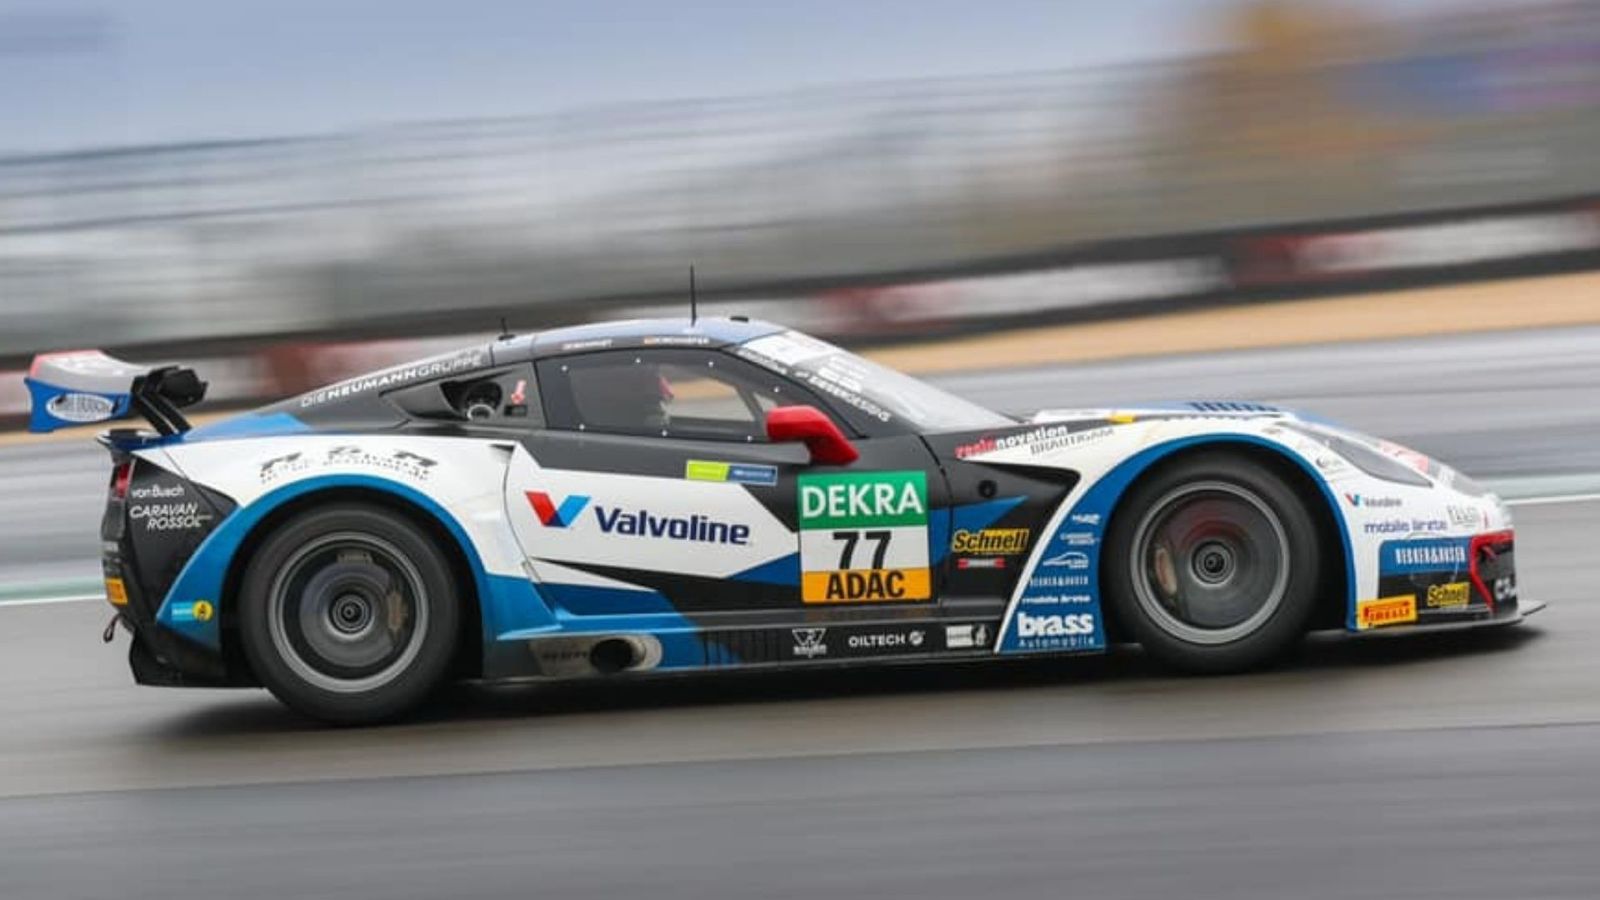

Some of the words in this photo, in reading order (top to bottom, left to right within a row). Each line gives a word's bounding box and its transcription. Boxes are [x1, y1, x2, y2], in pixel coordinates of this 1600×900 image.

[129, 501, 199, 519] CARAVAN
[801, 481, 925, 518] DEKRA
[146, 514, 204, 532] ROSSOL
[594, 506, 750, 546] Valvoline
[832, 530, 892, 570] 77
[953, 529, 1029, 551] Schnell
[826, 570, 906, 600] ADAC
[1017, 611, 1095, 638] brass
[848, 633, 906, 648] OILTECH
[1018, 636, 1096, 649] Automobile
